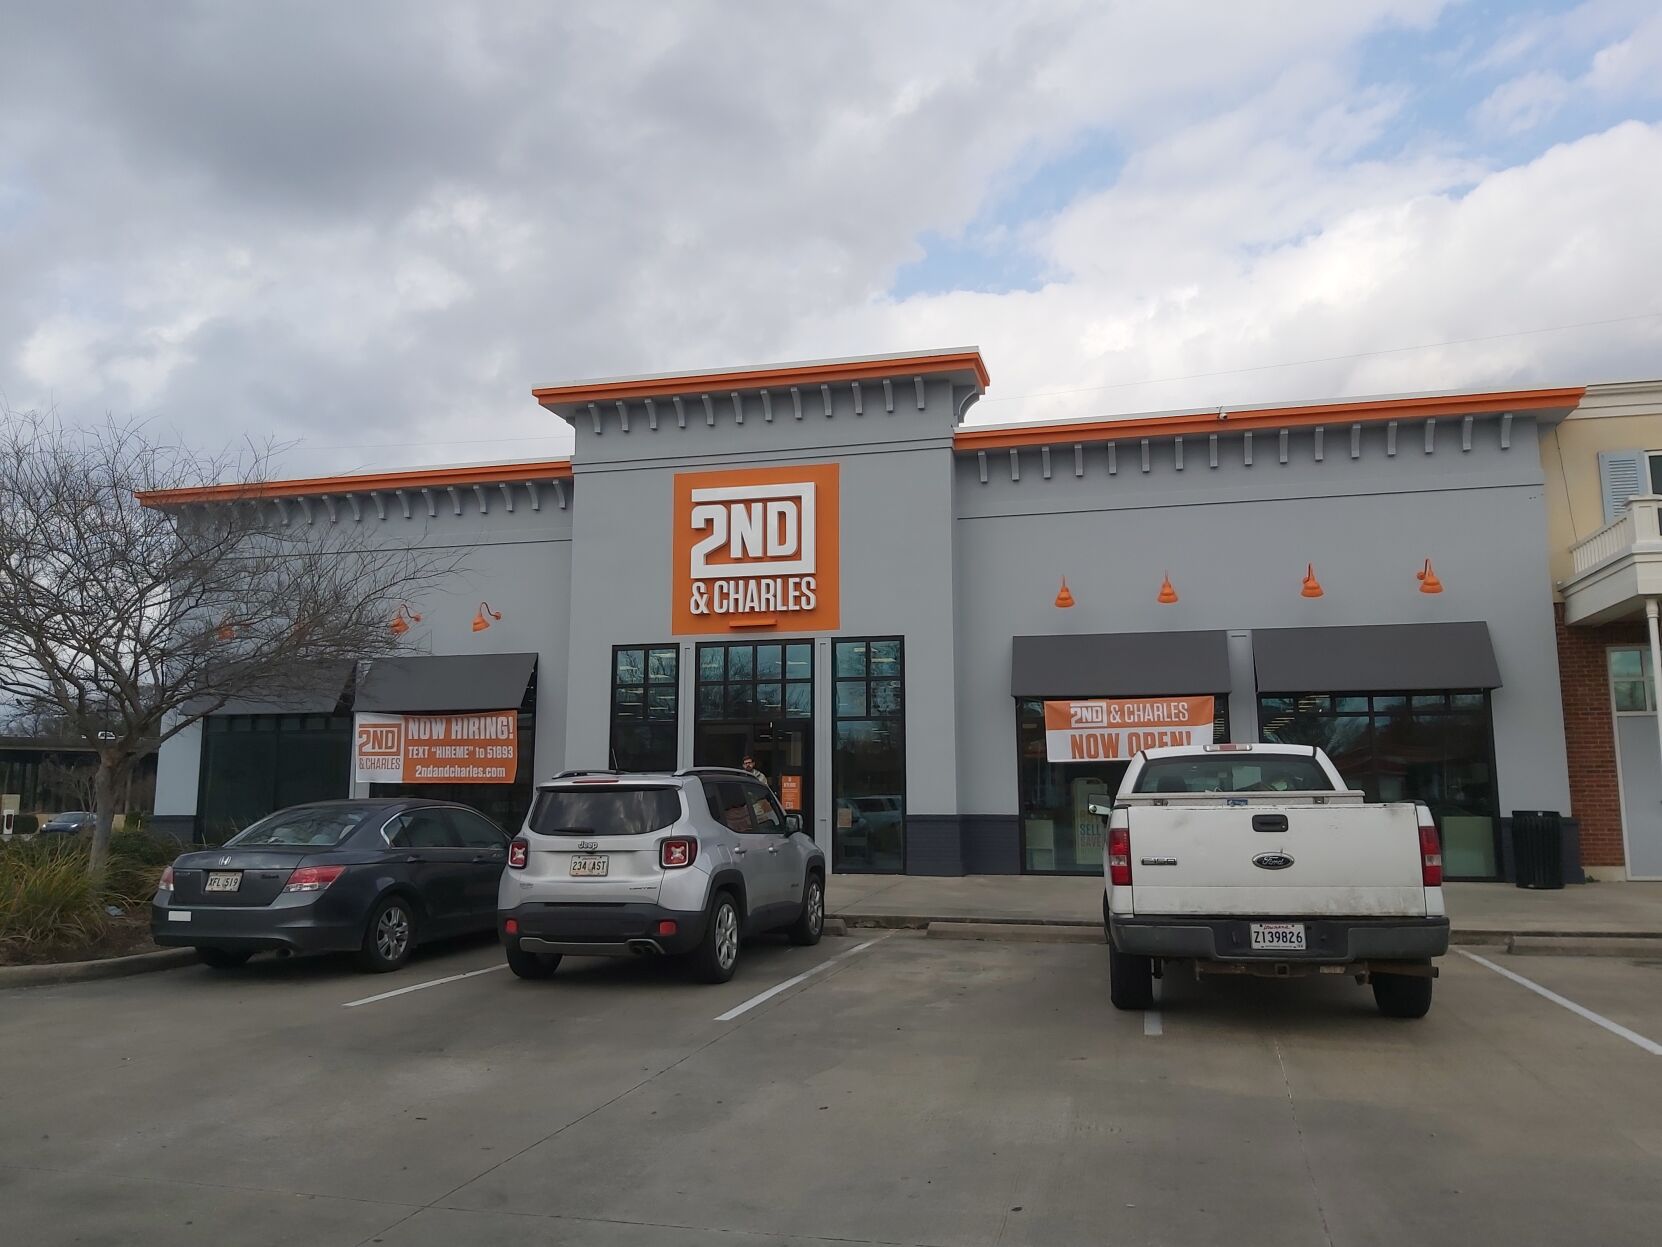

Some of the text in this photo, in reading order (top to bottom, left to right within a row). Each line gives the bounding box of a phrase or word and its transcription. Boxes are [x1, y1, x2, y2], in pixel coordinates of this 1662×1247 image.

[691, 499, 800, 579] 2ND
[690, 577, 817, 615] & CHARLES
[1070, 702, 1189, 728] 2ND & CHARLES
[408, 716, 514, 740] NOW HIRING!
[359, 728, 399, 756] 2ND
[1070, 732, 1120, 760] NOW
[408, 746, 429, 759] TEXT
[475, 747, 485, 758] to
[487, 746, 514, 758] 51893
[415, 765, 506, 778] 2ndandcharles.com
[1080, 823, 1102, 836] SELL
[578, 841, 598, 849] Jeep
[572, 860, 606, 871] 234 AST
[1261, 855, 1284, 866] Ford
[208, 876, 239, 887] XFL 519
[1253, 931, 1303, 944] Z139826
